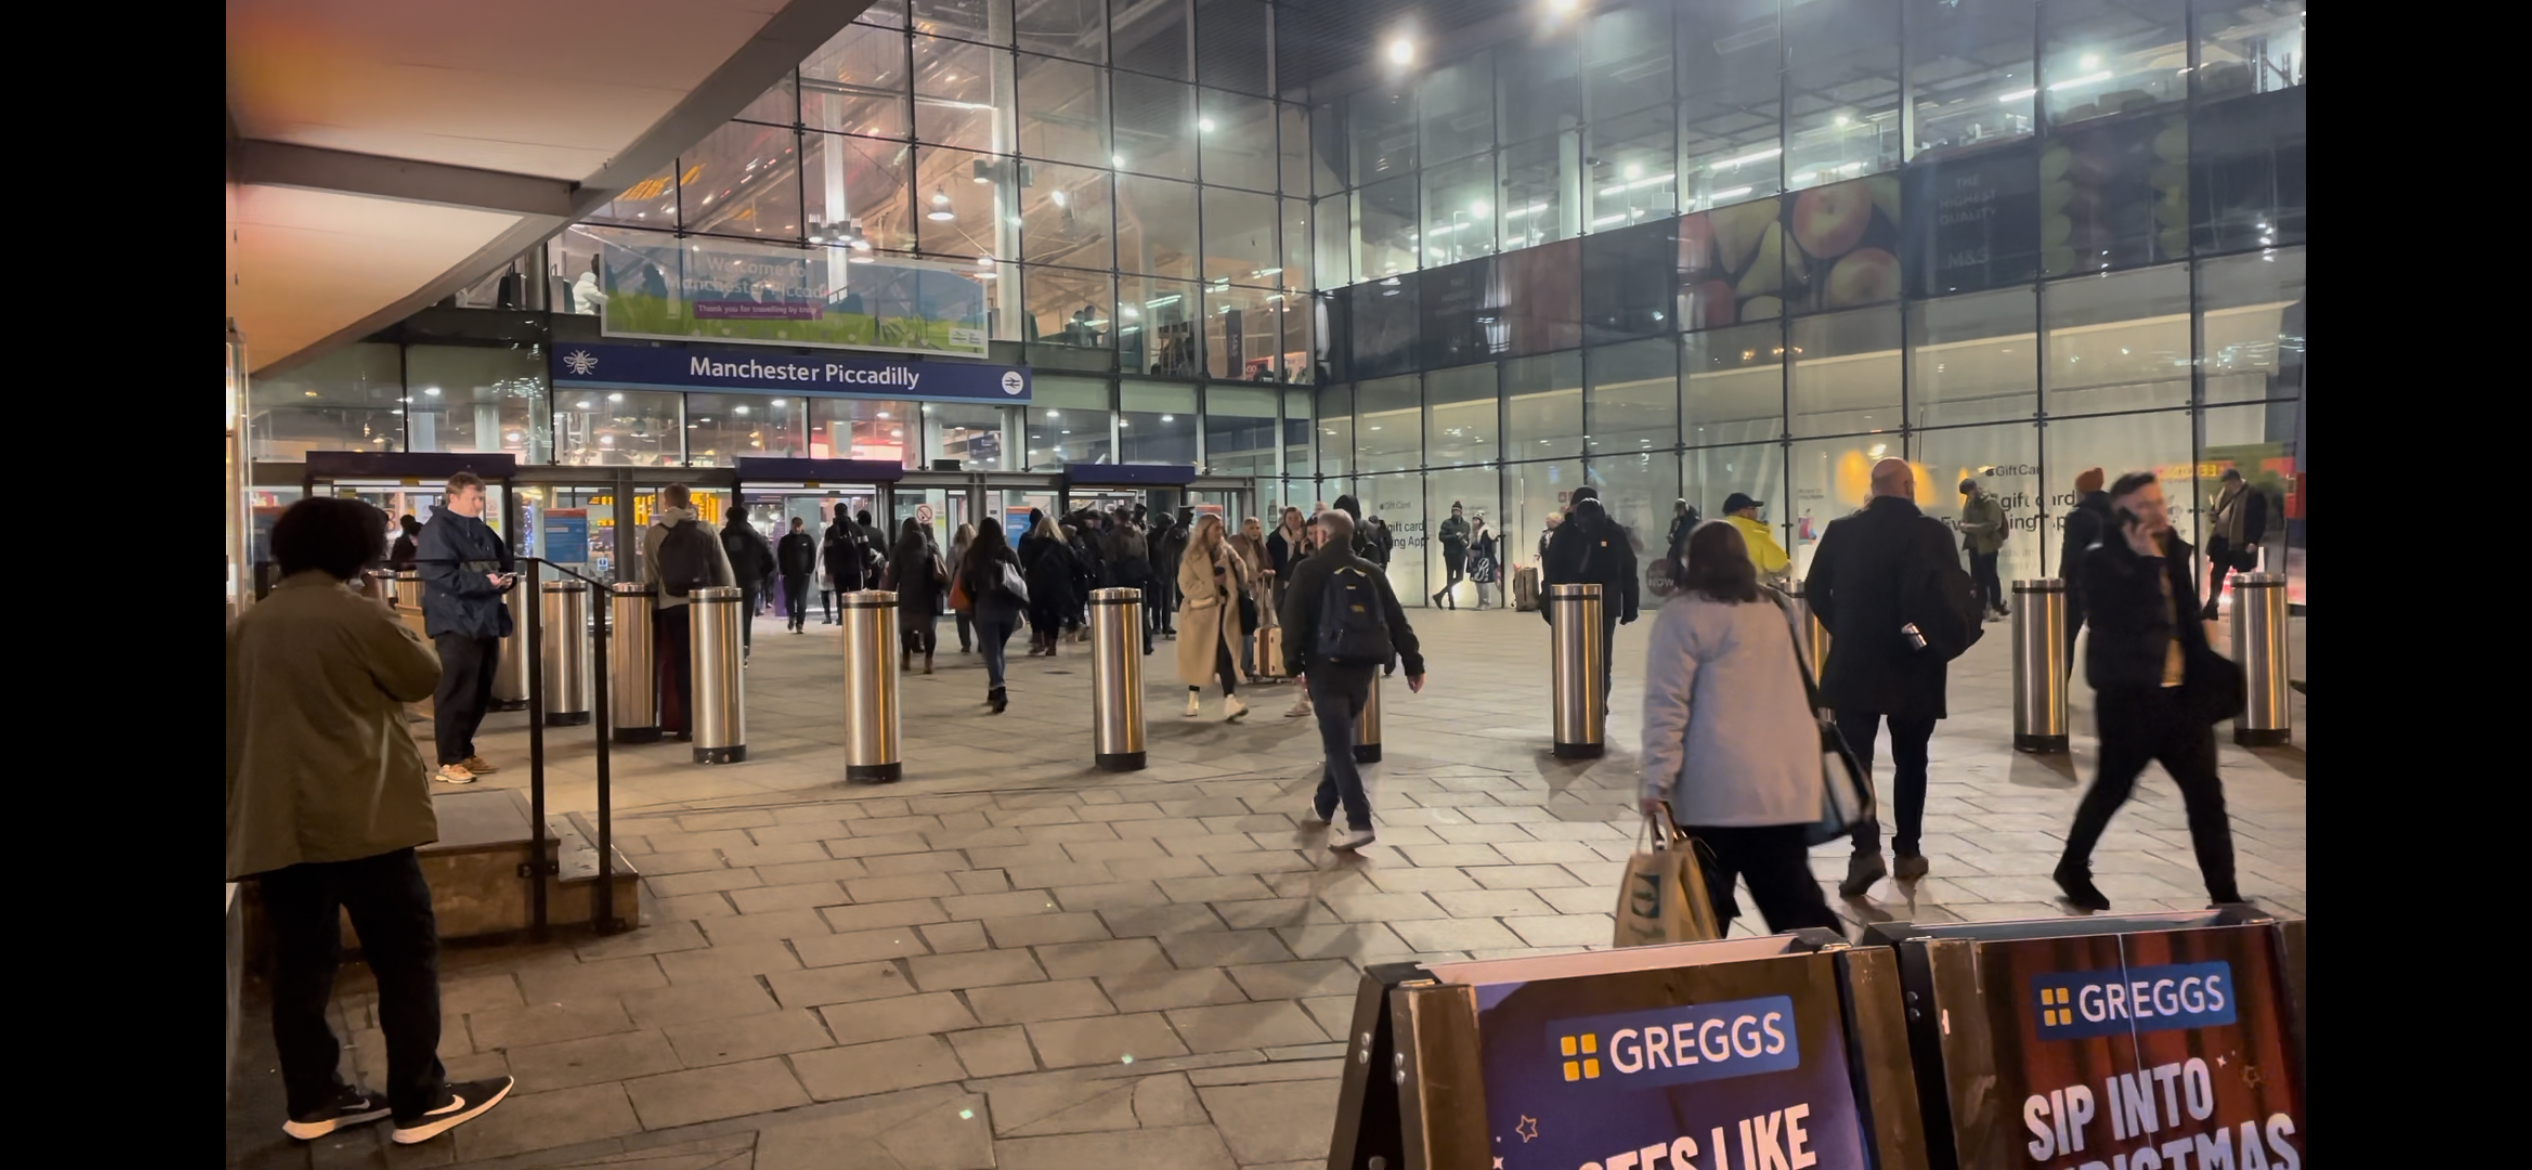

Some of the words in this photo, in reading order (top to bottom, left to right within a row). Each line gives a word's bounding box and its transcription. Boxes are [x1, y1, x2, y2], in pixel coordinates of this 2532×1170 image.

[706, 254, 785, 276] Welcome
[788, 260, 806, 278] to
[1948, 246, 1990, 270] M&S
[698, 304, 722, 313] Thank
[724, 306, 738, 316] you
[740, 305, 749, 314] for
[751, 305, 787, 315] travelling
[788, 307, 798, 316] by
[690, 356, 820, 382] Manchester
[825, 363, 920, 390] Piccadilly
[1995, 465, 2017, 477] Gift
[2018, 464, 2040, 476] Car
[2001, 491, 2030, 511] gift
[1387, 522, 1403, 533] gift
[2079, 975, 2225, 1023] GREGGS
[1610, 1012, 1786, 1074] GREGGS
[2023, 1084, 2095, 1162] SIP
[2106, 1057, 2214, 1141] INTO
